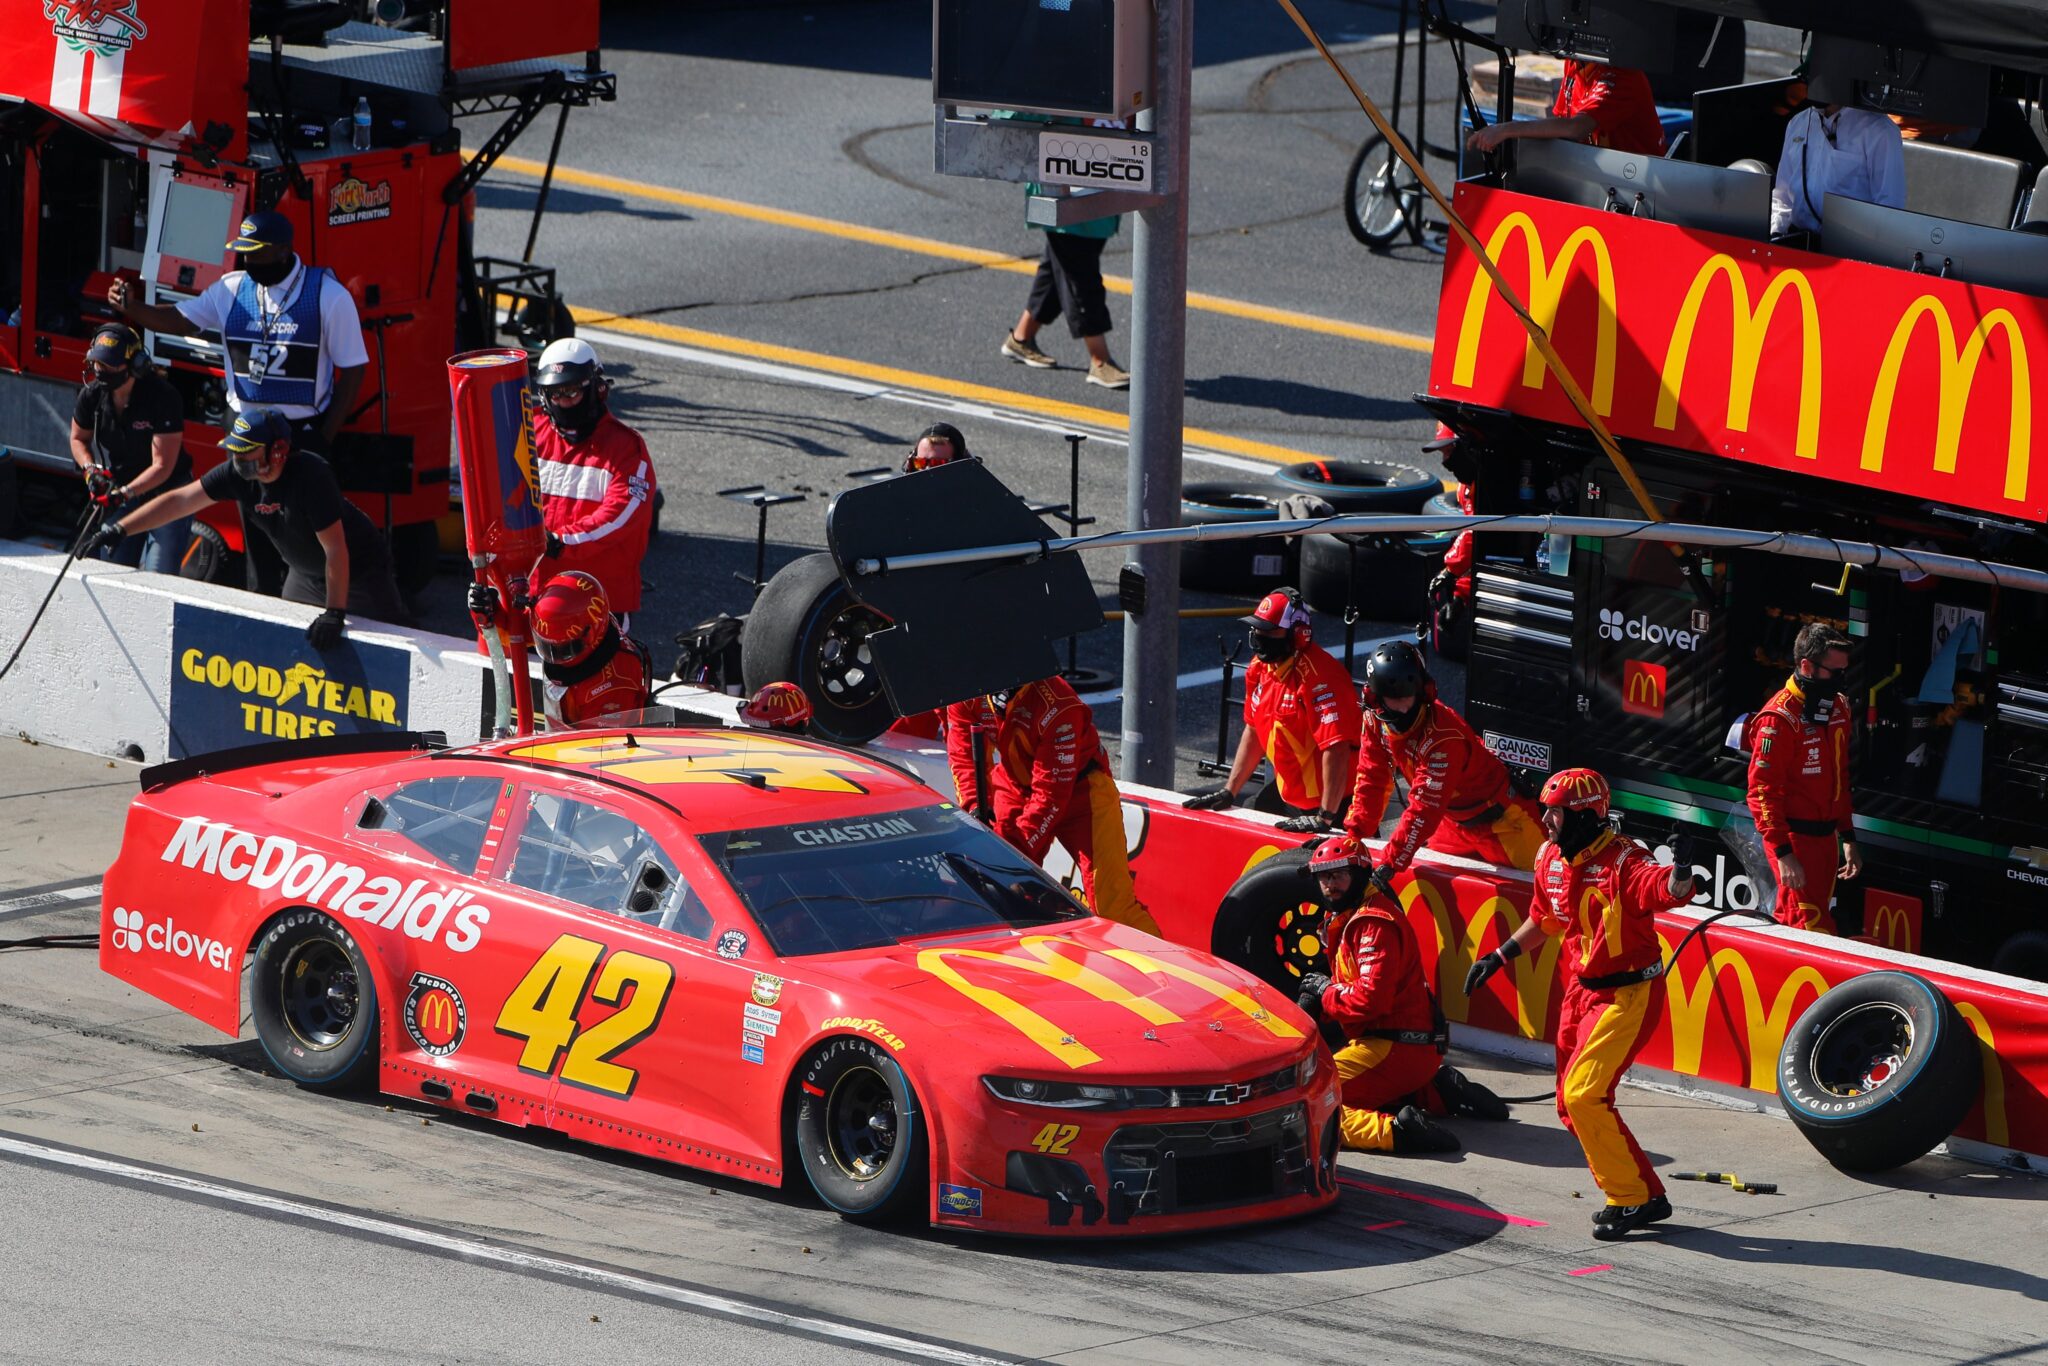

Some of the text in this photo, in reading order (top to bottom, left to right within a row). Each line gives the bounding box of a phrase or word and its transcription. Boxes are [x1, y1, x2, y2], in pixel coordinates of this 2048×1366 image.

[75, 30, 98, 41] WARE
[99, 35, 130, 46] RACING
[329, 207, 390, 226] SCREEN PRINTING
[248, 344, 289, 376] 52
[1625, 615, 1700, 652] clover
[181, 648, 399, 726] GOODYEAR
[1497, 738, 1549, 761] GANASSI
[792, 817, 918, 846] CHASTAIN
[160, 815, 491, 953] McDonald's
[1691, 854, 1760, 911] clo
[145, 916, 232, 973] clover
[269, 911, 355, 950] GOODYEAR
[406, 997, 456, 1055] RACING TEAM
[493, 933, 677, 1101] 42
[746, 1019, 774, 1034] SIEMENS
[821, 1017, 906, 1051] GOODYEAR
[804, 1040, 877, 1090] OODYEAR
[1031, 1122, 1081, 1155] 42
[942, 1195, 980, 1208] SUNOCO
